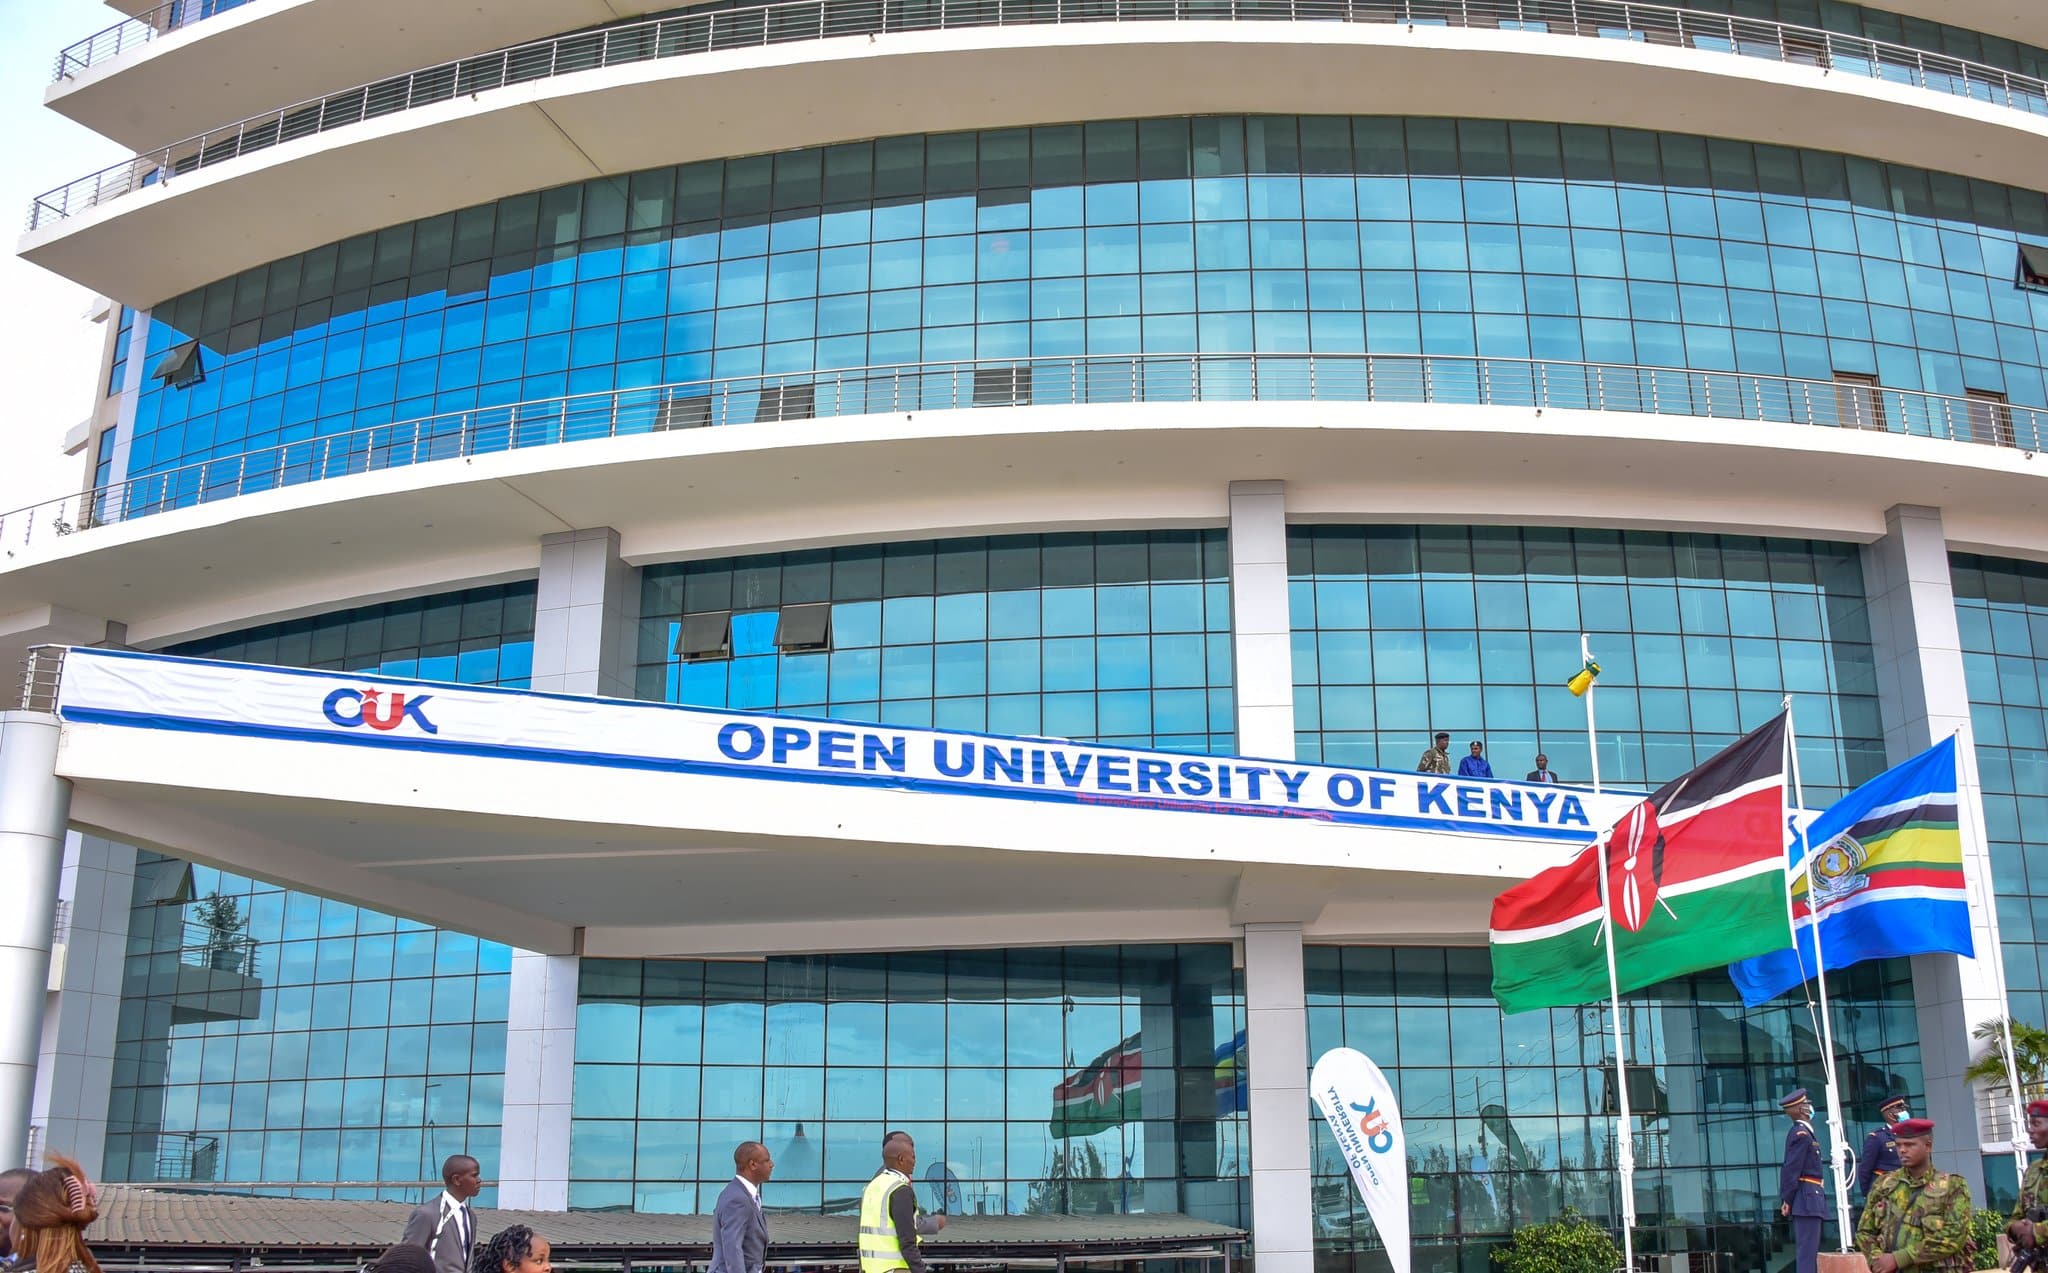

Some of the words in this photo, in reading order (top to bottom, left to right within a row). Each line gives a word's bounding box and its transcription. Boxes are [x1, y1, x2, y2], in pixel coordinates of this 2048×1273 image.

[323, 687, 438, 734] OUK
[717, 722, 905, 772] OPEN
[933, 739, 1310, 802] UNIVERSITY
[1327, 773, 1396, 809] OF
[1417, 781, 1590, 826] KENYA
